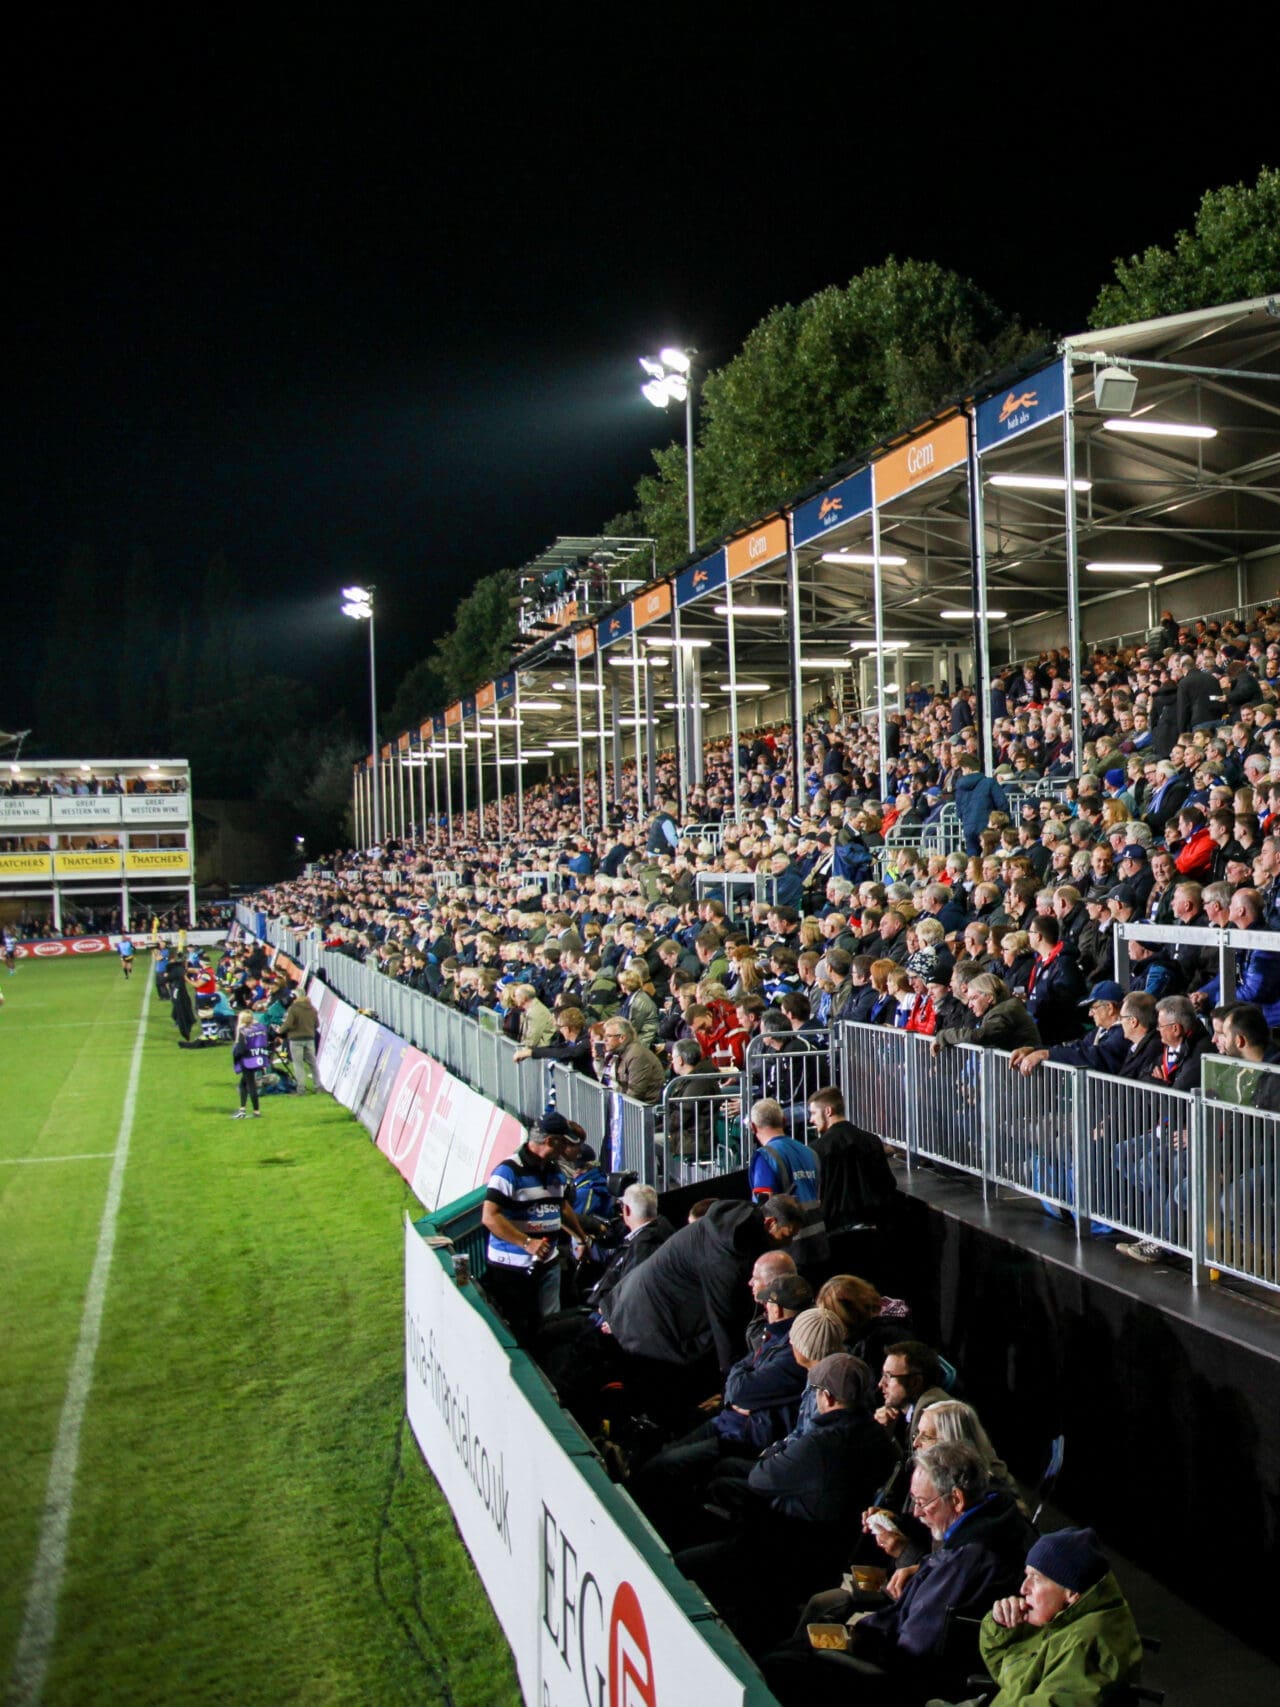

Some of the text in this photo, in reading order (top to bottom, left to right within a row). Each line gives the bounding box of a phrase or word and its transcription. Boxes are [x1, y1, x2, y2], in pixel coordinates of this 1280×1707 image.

[908, 443, 934, 473] Gem
[748, 535, 767, 559] Gem
[62, 855, 116, 866] THATCHERS
[131, 854, 184, 864] THATCHERS
[541, 1498, 606, 1707] EFG
